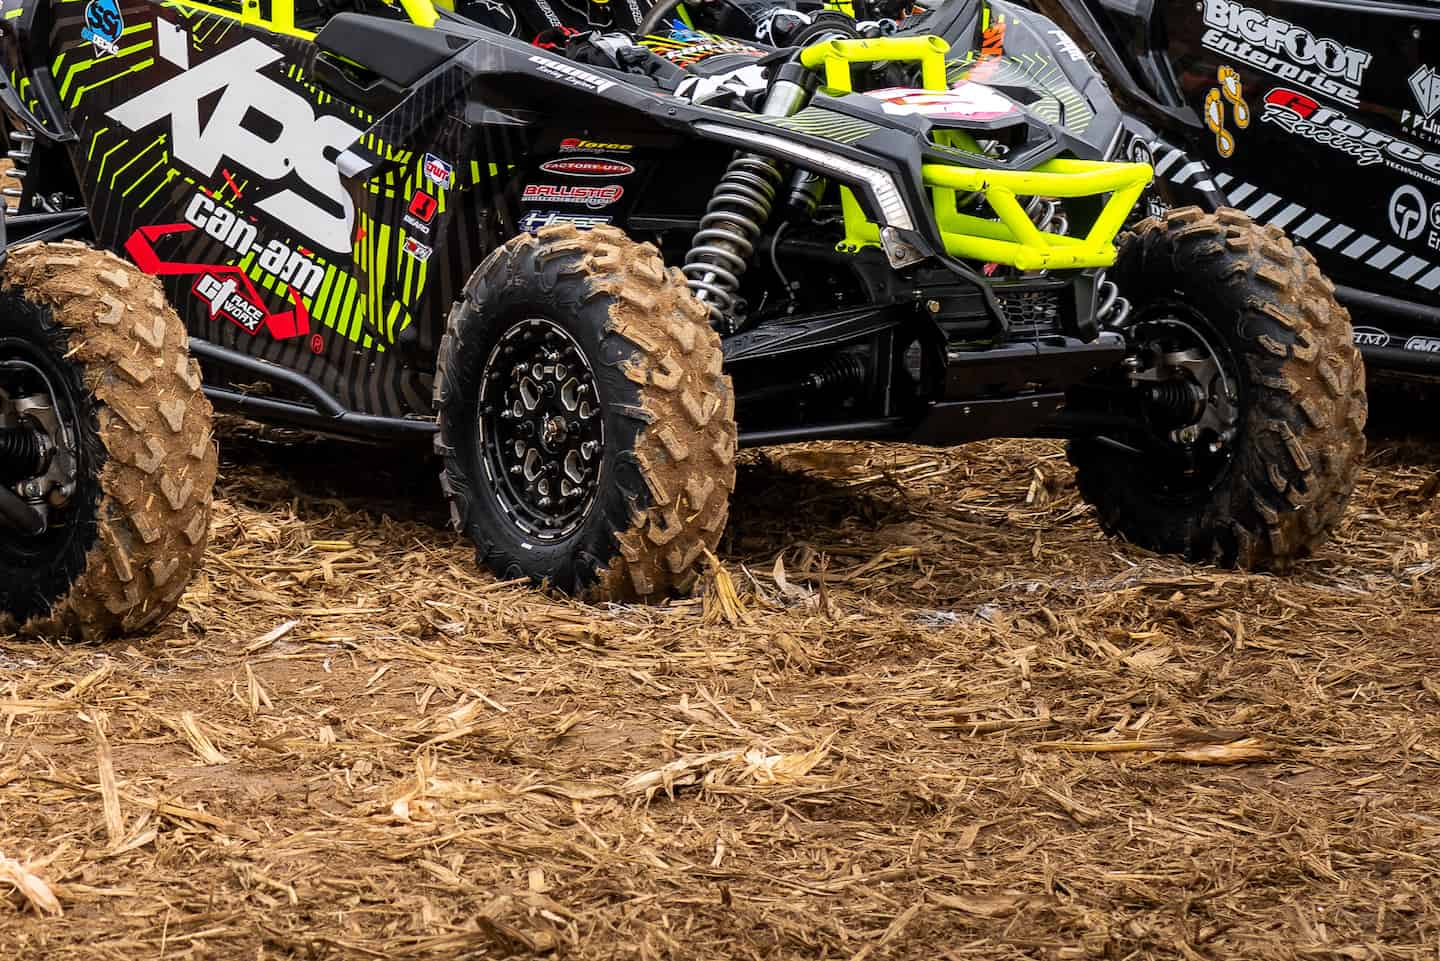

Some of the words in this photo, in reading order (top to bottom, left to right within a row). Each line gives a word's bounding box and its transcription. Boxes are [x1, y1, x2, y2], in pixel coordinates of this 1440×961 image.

[1201, 28, 1361, 104] Enterprise
[104, 16, 364, 254] XPS
[1260, 103, 1384, 167] Racing
[523, 184, 622, 199] BALLISTIC
[184, 191, 326, 298] can-am
[223, 301, 259, 331] WORX
[230, 294, 264, 321] RACE
